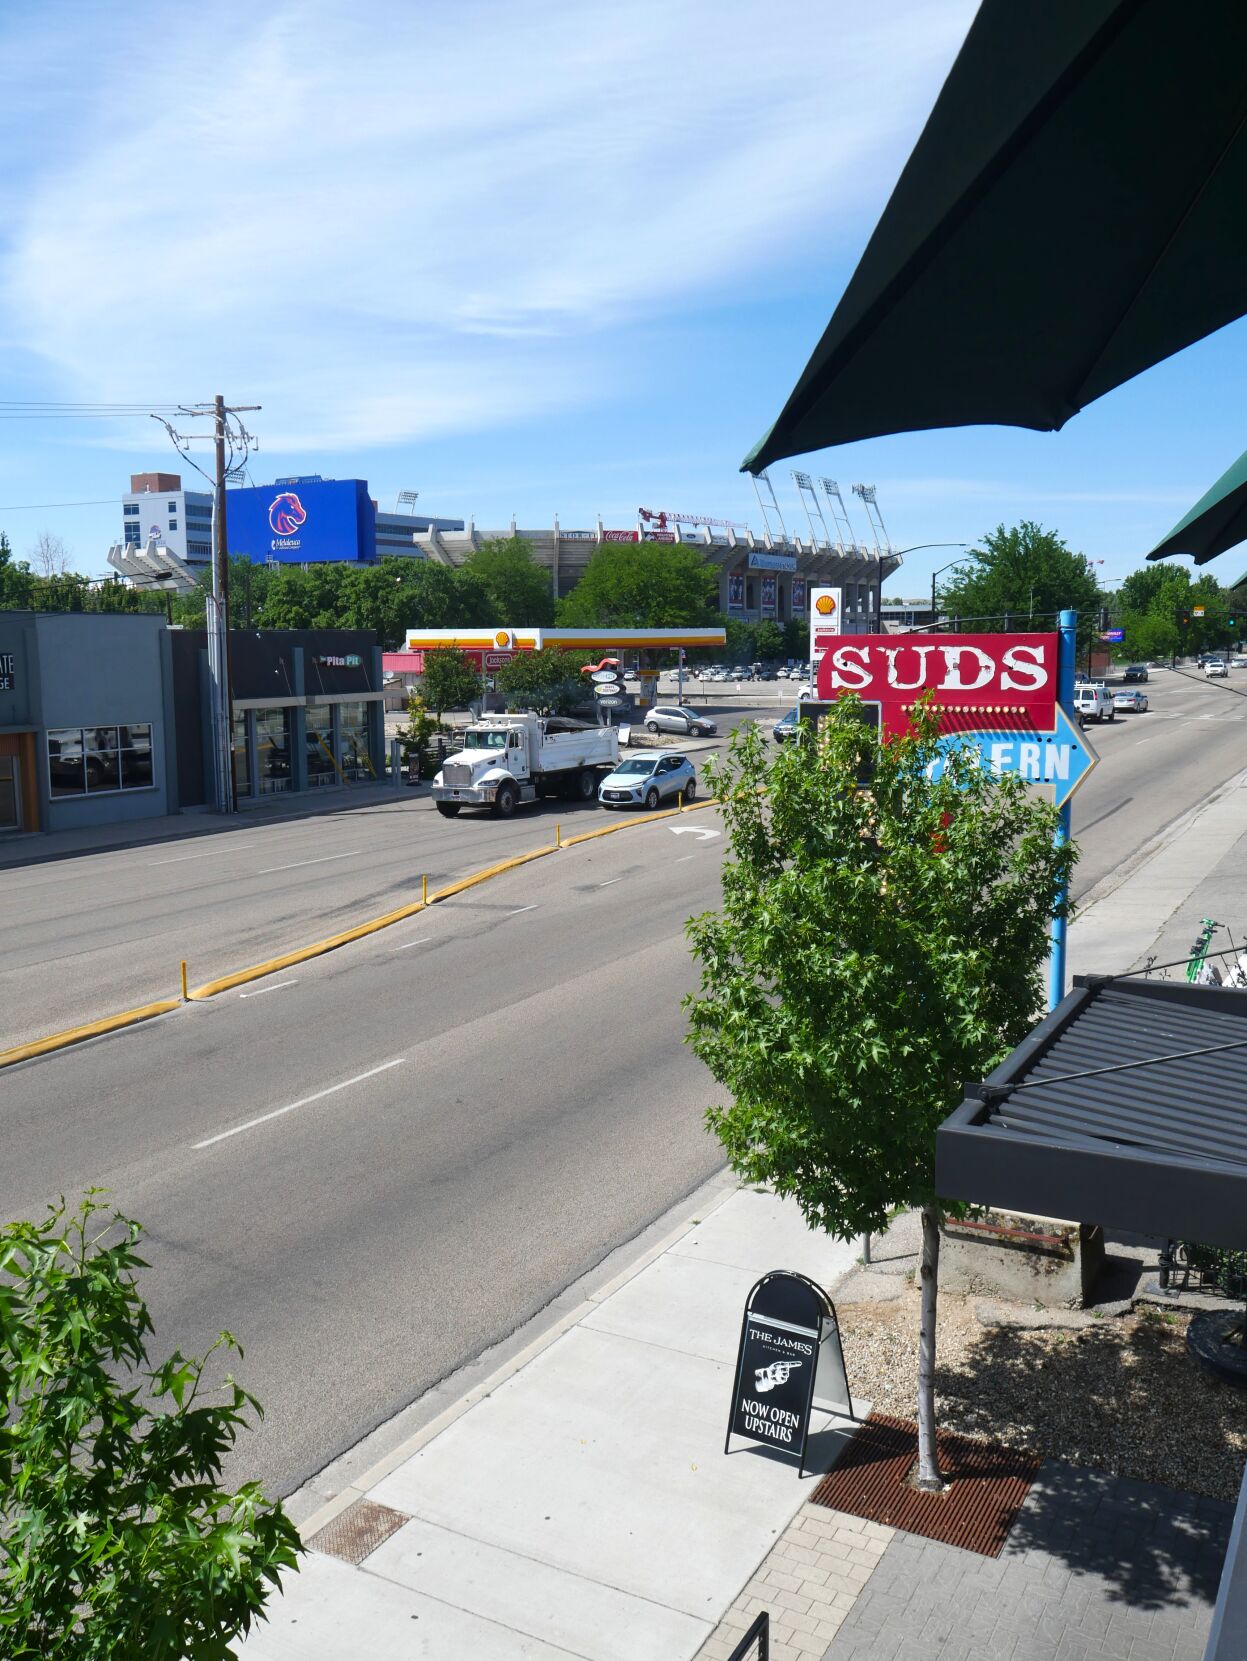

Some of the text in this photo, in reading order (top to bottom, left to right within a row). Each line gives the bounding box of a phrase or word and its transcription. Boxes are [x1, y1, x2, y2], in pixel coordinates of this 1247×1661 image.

[326, 656, 345, 667] Pita
[346, 656, 359, 666] Pit
[831, 645, 1049, 691] SUDS
[749, 1328, 813, 1355] THE JAMES
[741, 1398, 800, 1429] NOW OPEN
[745, 1415, 793, 1443] UPSTAIRS
